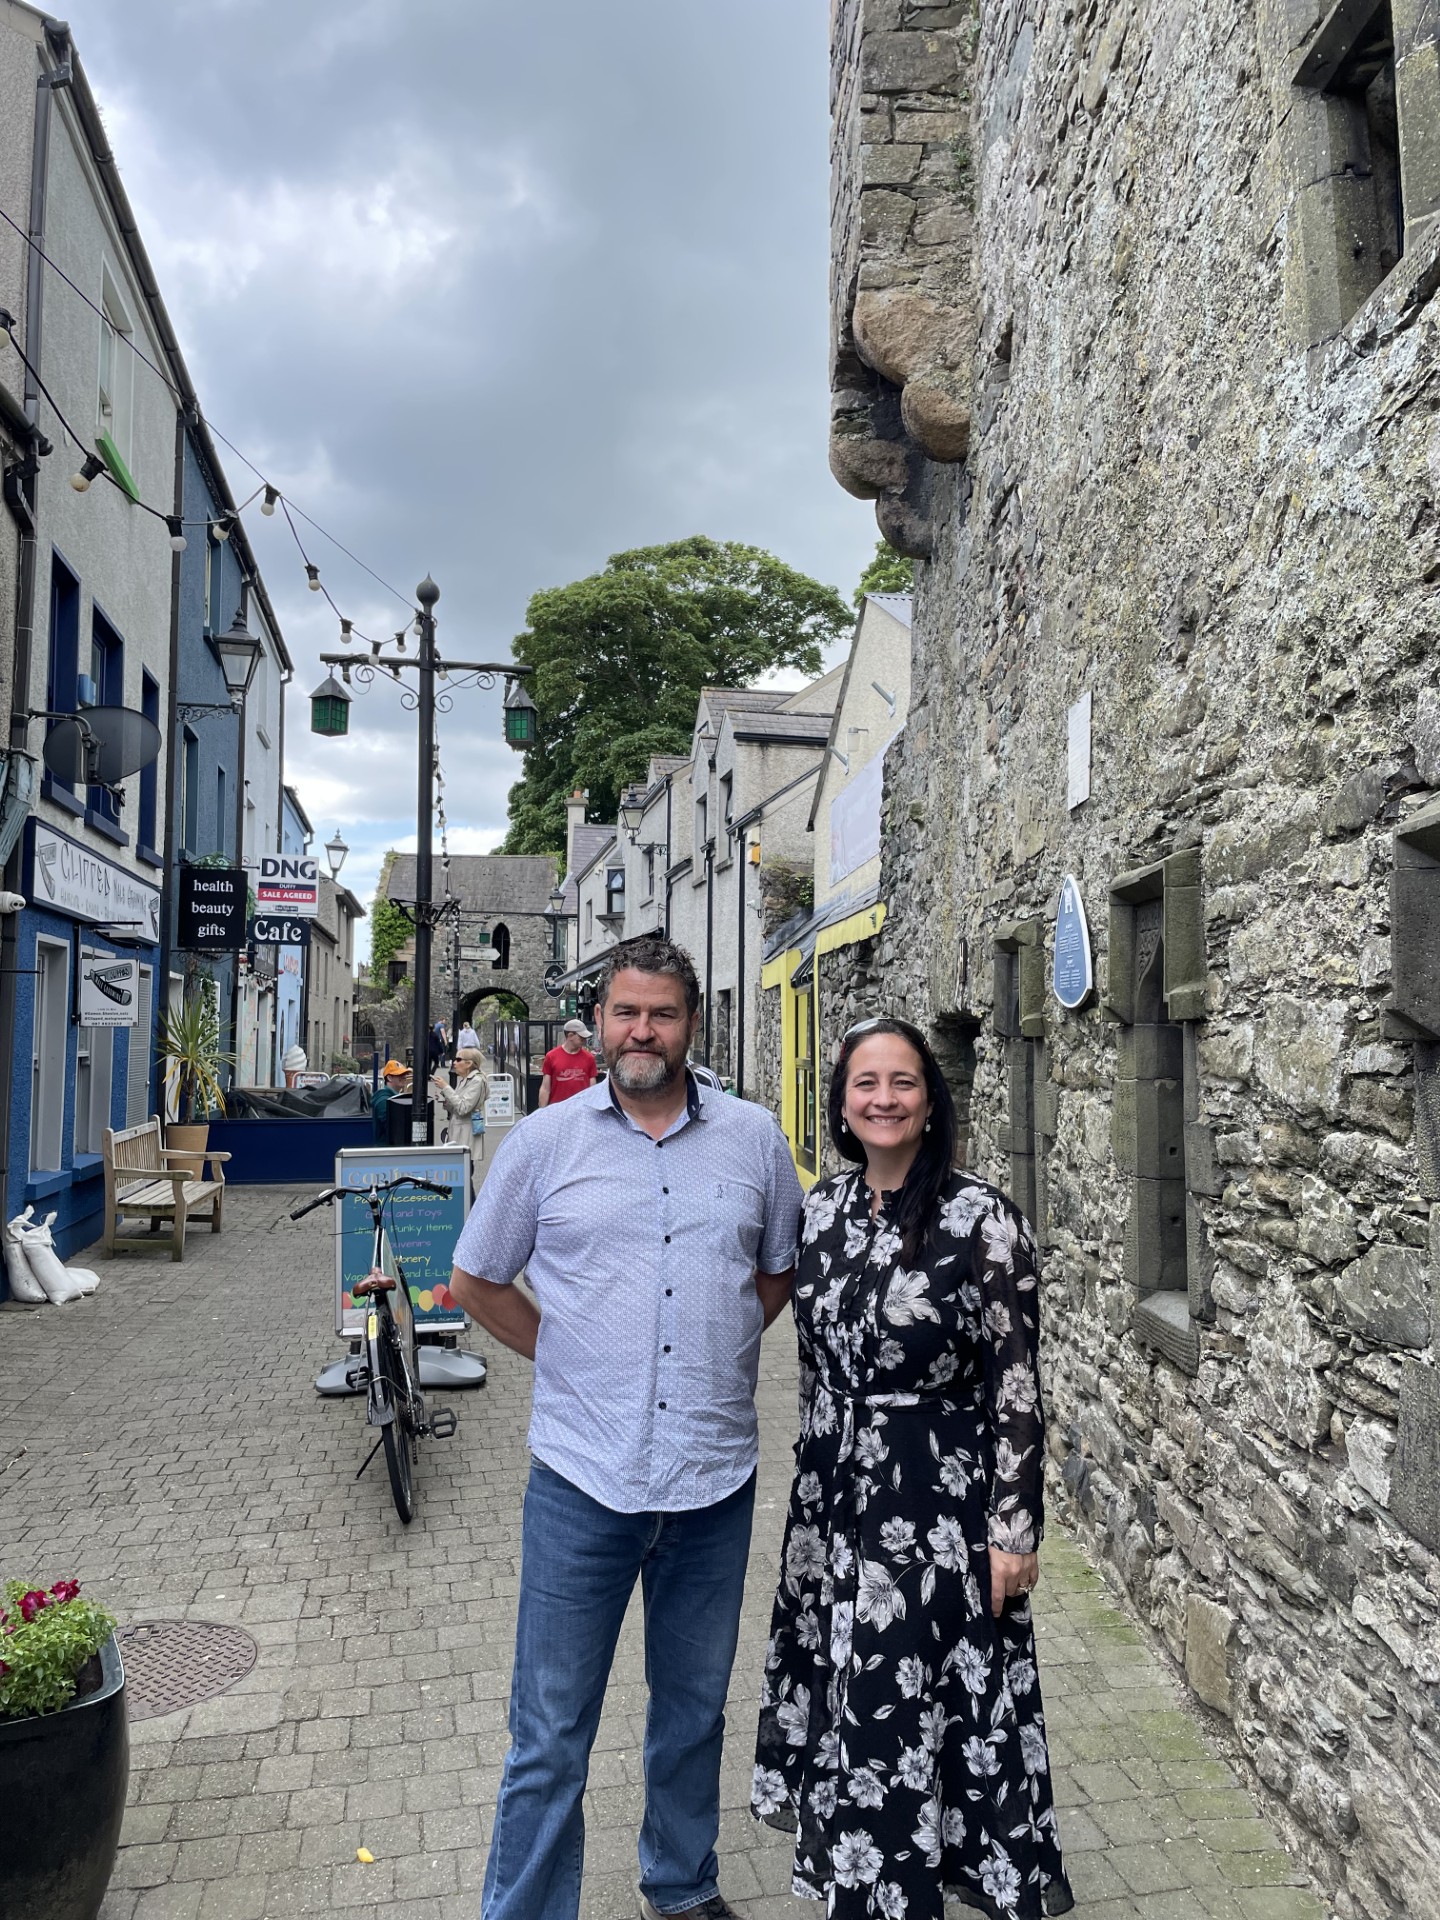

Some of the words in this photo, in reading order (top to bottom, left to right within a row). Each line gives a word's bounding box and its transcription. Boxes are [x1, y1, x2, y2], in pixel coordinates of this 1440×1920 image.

[261, 858, 317, 880] DNG
[193, 879, 234, 893] health
[284, 892, 313, 900] AGREED
[191, 901, 234, 917] beauty
[197, 923, 226, 937] gifts
[254, 920, 302, 941] Cafe
[354, 1195, 385, 1206] Pay
[396, 1208, 414, 1218] and
[417, 1208, 442, 1220] Toys
[426, 1223, 453, 1232] Items
